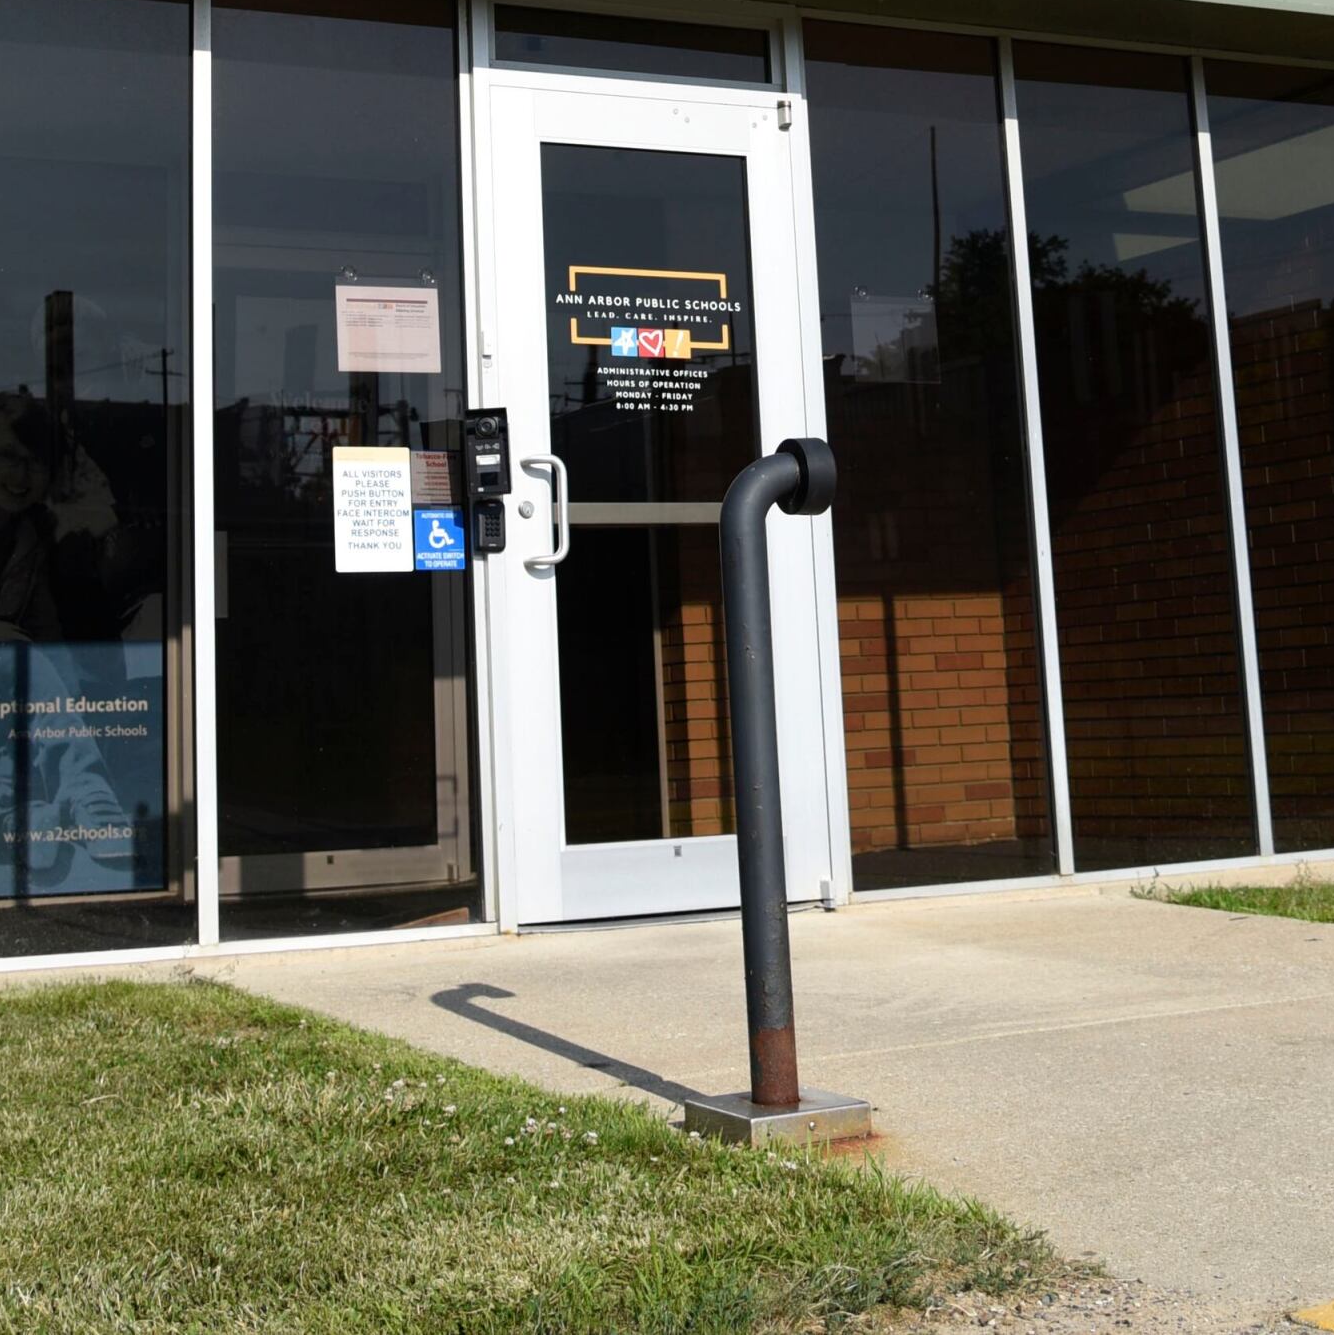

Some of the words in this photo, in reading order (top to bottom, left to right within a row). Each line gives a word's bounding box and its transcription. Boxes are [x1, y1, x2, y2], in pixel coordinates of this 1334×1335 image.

[555, 294, 583, 305] ANN
[588, 296, 631, 307] ARBOR
[635, 297, 680, 309] PUBLIC
[685, 300, 742, 312] SCHOOLS
[587, 311, 620, 319] LEAD.
[625, 312, 658, 321] CARE.
[663, 314, 713, 323] INSPIRE.
[597, 367, 670, 377] ADMINISTRATIVE
[673, 369, 708, 378] OFFICES
[606, 379, 636, 388] HOURS
[638, 380, 650, 388] OF
[652, 381, 701, 390] OPERATION
[615, 391, 652, 399] MONDAY
[661, 392, 693, 400] FRIDAY
[616, 402, 635, 410] 8:00
[362, 470, 402, 478] VISITORS
[355, 480, 390, 488] PLEASE
[341, 489, 366, 498] PUSH
[368, 489, 405, 498] BUTTON
[348, 499, 367, 507] FOR
[369, 499, 398, 507] ENTRY
[337, 509, 361, 517] FACE
[363, 509, 410, 518] INTERCOM
[352, 519, 374, 527] WAIT
[377, 519, 396, 527] FOR
[351, 529, 400, 537] RESPONSE
[348, 542, 380, 550] THANK
[382, 542, 402, 550] YOU
[66, 696, 148, 713] Education
[34, 726, 66, 738] Arbor
[69, 726, 102, 738] Public
[104, 724, 148, 737] Schools
